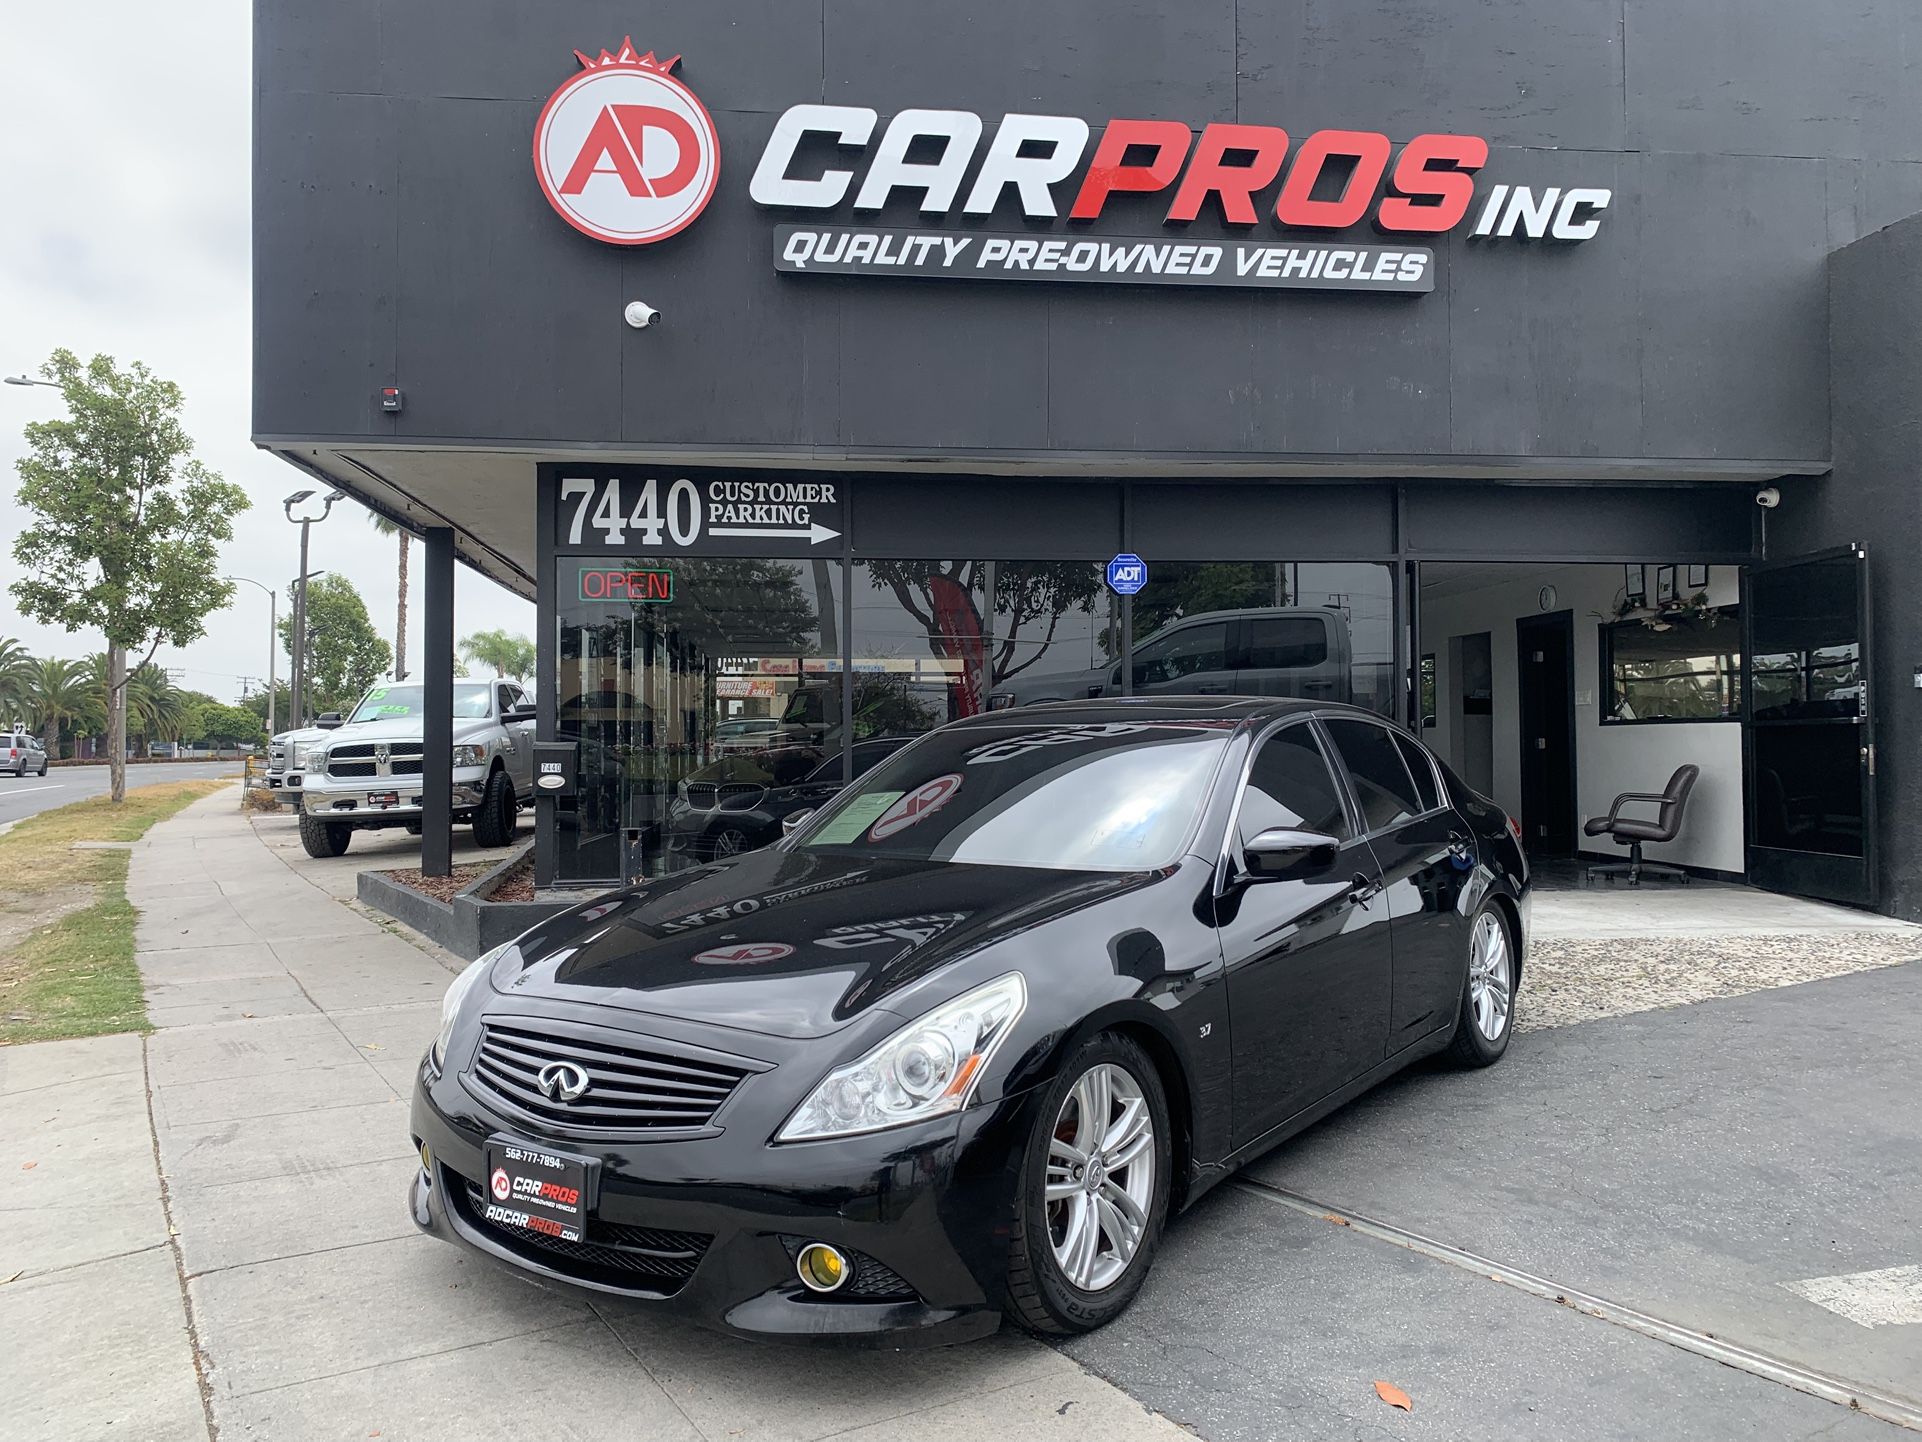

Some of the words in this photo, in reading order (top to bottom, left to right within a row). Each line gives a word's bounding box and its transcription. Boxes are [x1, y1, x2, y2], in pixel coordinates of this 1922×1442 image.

[559, 103, 699, 198] AD
[1475, 184, 1611, 241] INC
[783, 231, 972, 268] QUALITY
[976, 239, 1222, 275] PRE-OWNED
[1236, 247, 1427, 282] VEHICLES
[708, 481, 836, 503] CUSTOMER
[561, 478, 701, 547] 7440
[708, 503, 811, 525] PARKING
[583, 571, 670, 599] OPEN
[1114, 566, 1141, 581] ADT
[505, 1147, 561, 1169] 562-777-7894
